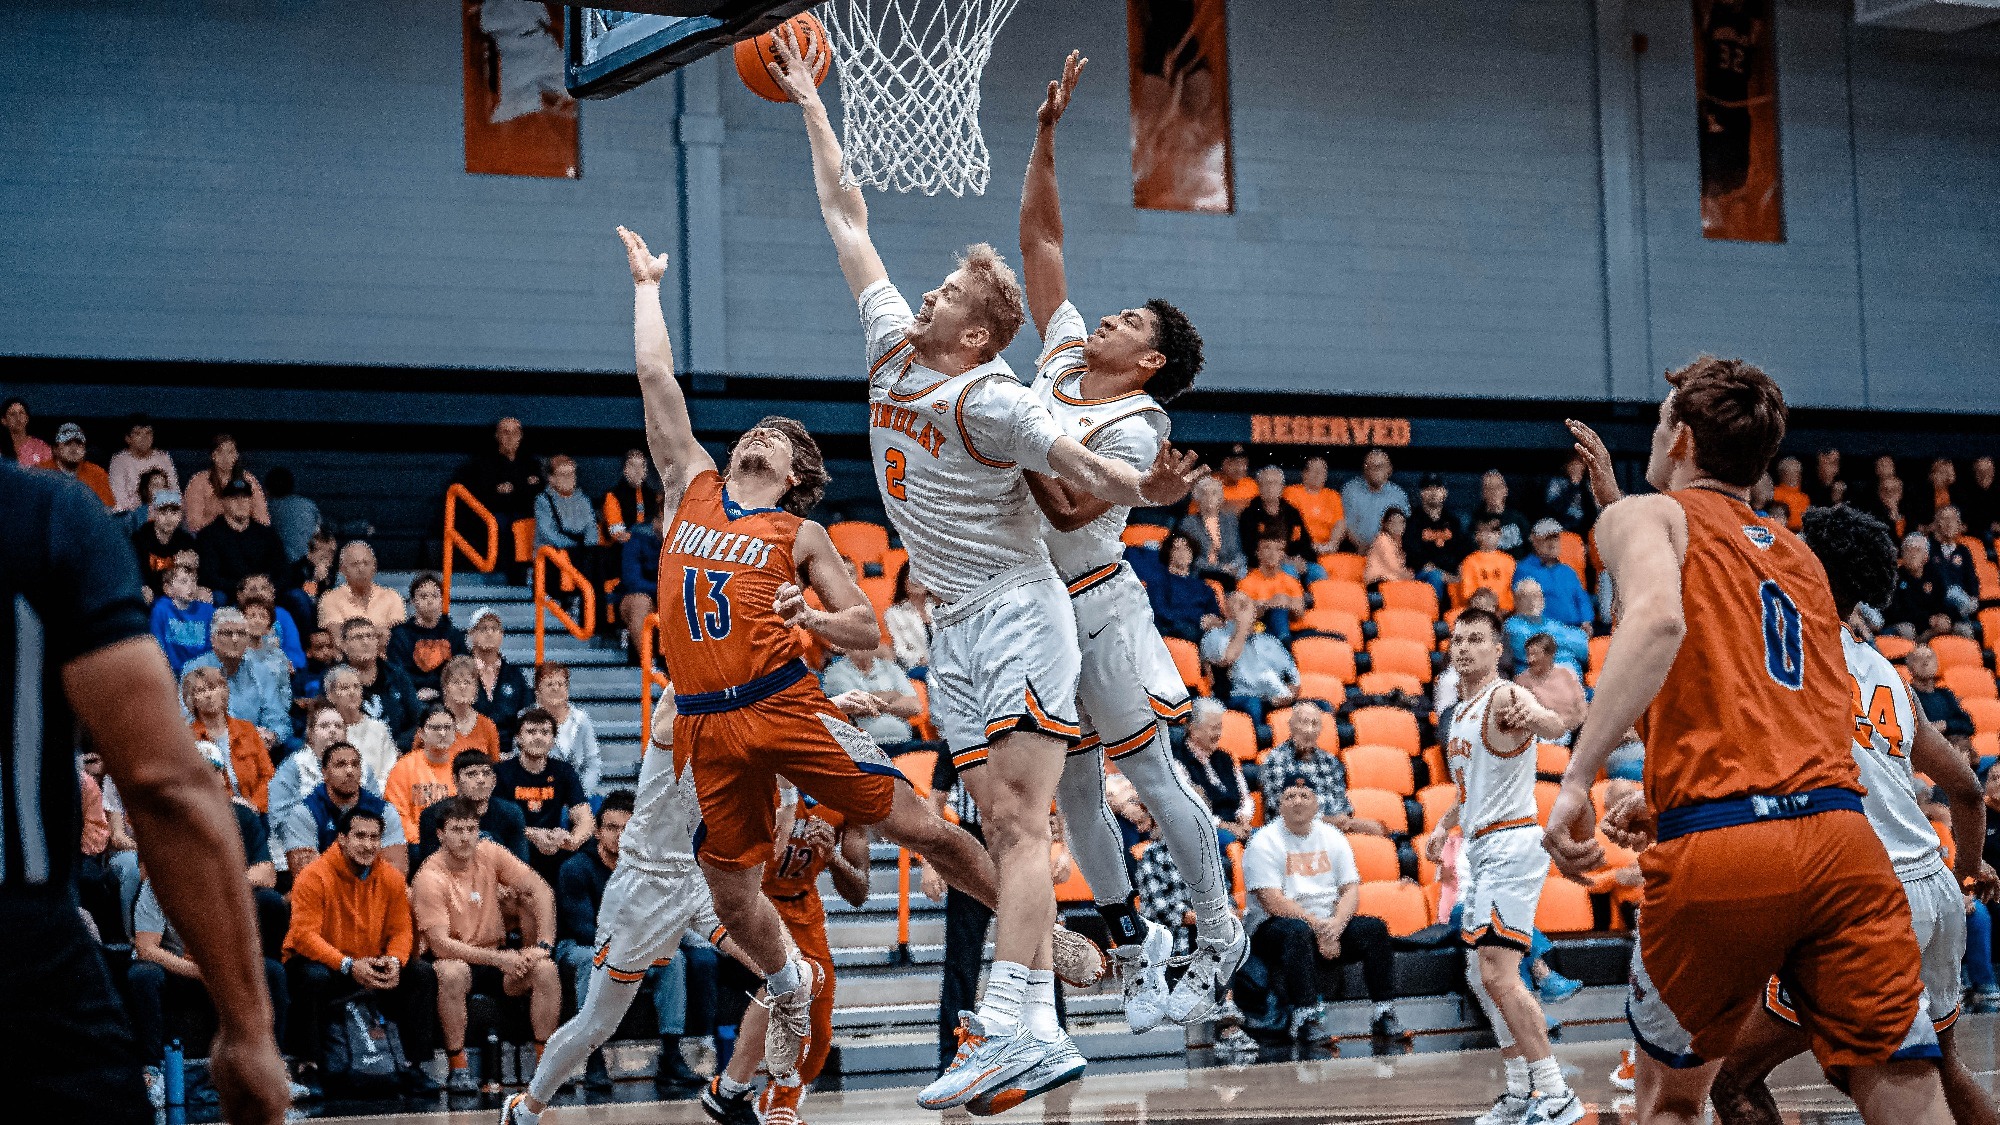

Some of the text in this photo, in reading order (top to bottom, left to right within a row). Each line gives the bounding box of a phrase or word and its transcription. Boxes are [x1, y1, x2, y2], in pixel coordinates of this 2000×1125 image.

[1251, 414, 1411, 447] RESERVED
[885, 447, 907, 502] 2
[667, 520, 775, 569] PIONEERS
[682, 565, 735, 641] 13
[1759, 578, 1804, 691] 0
[777, 843, 813, 878] 12
